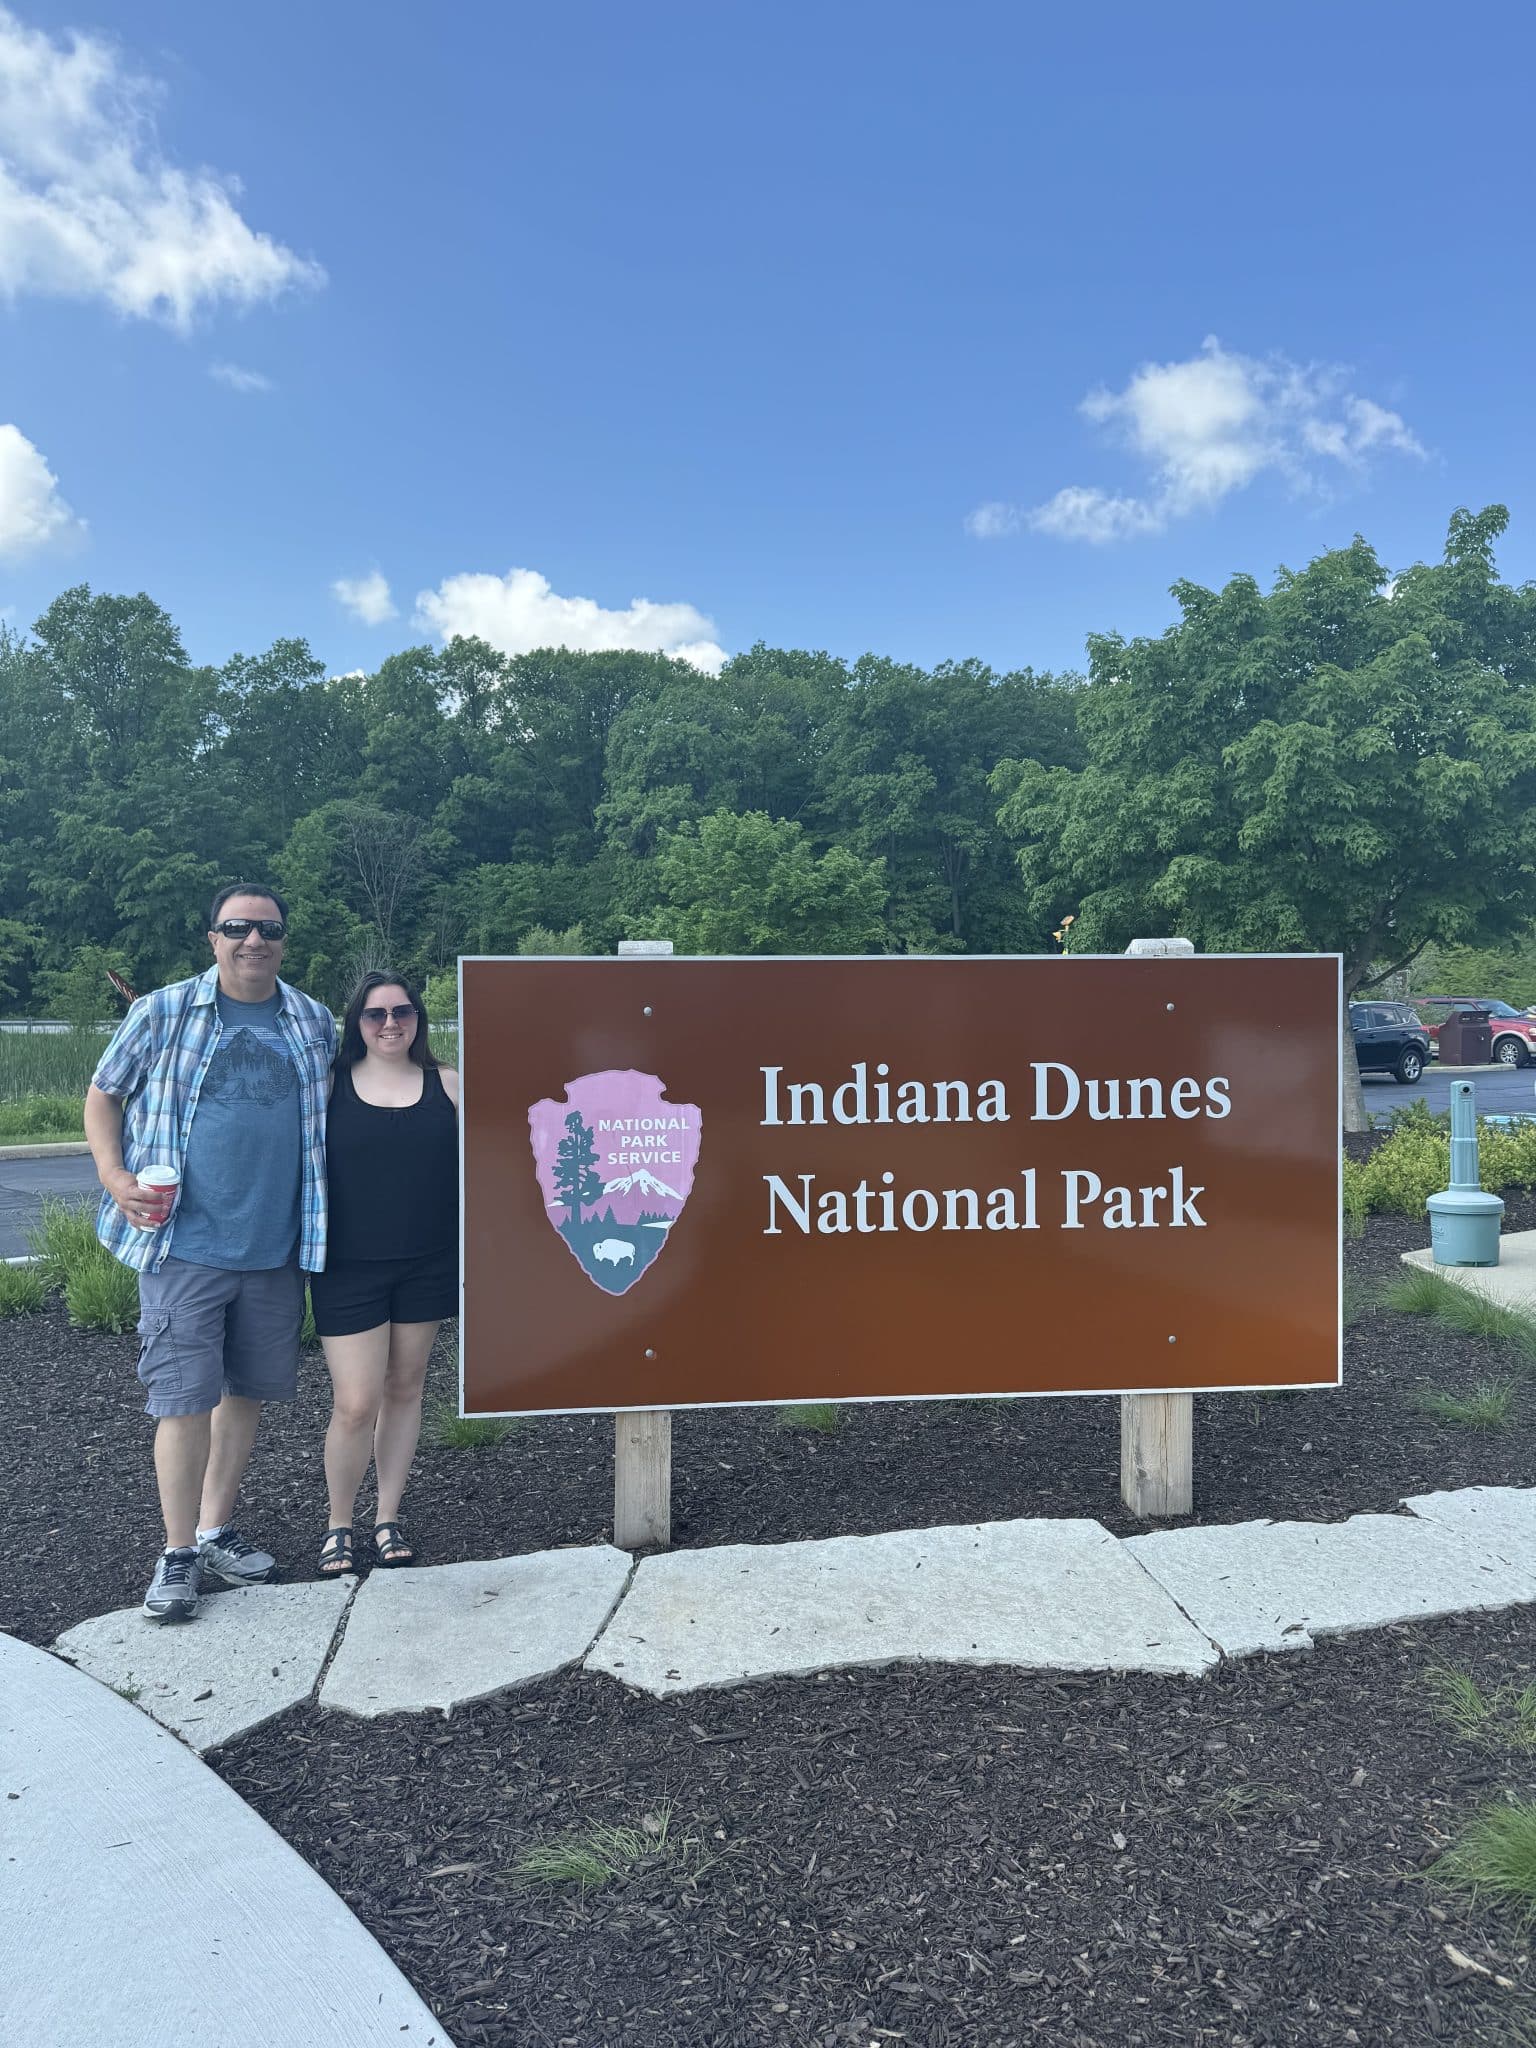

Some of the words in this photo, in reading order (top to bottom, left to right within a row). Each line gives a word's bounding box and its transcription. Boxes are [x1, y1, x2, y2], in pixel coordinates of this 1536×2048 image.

[759, 1062, 1011, 1126] Indiana
[1029, 1062, 1232, 1121] Dunes
[598, 1117, 690, 1132] NATIONAL
[621, 1134, 668, 1148] PARK
[607, 1150, 682, 1165] SERVICE
[762, 1168, 1041, 1234] National
[1060, 1166, 1208, 1229] Park
